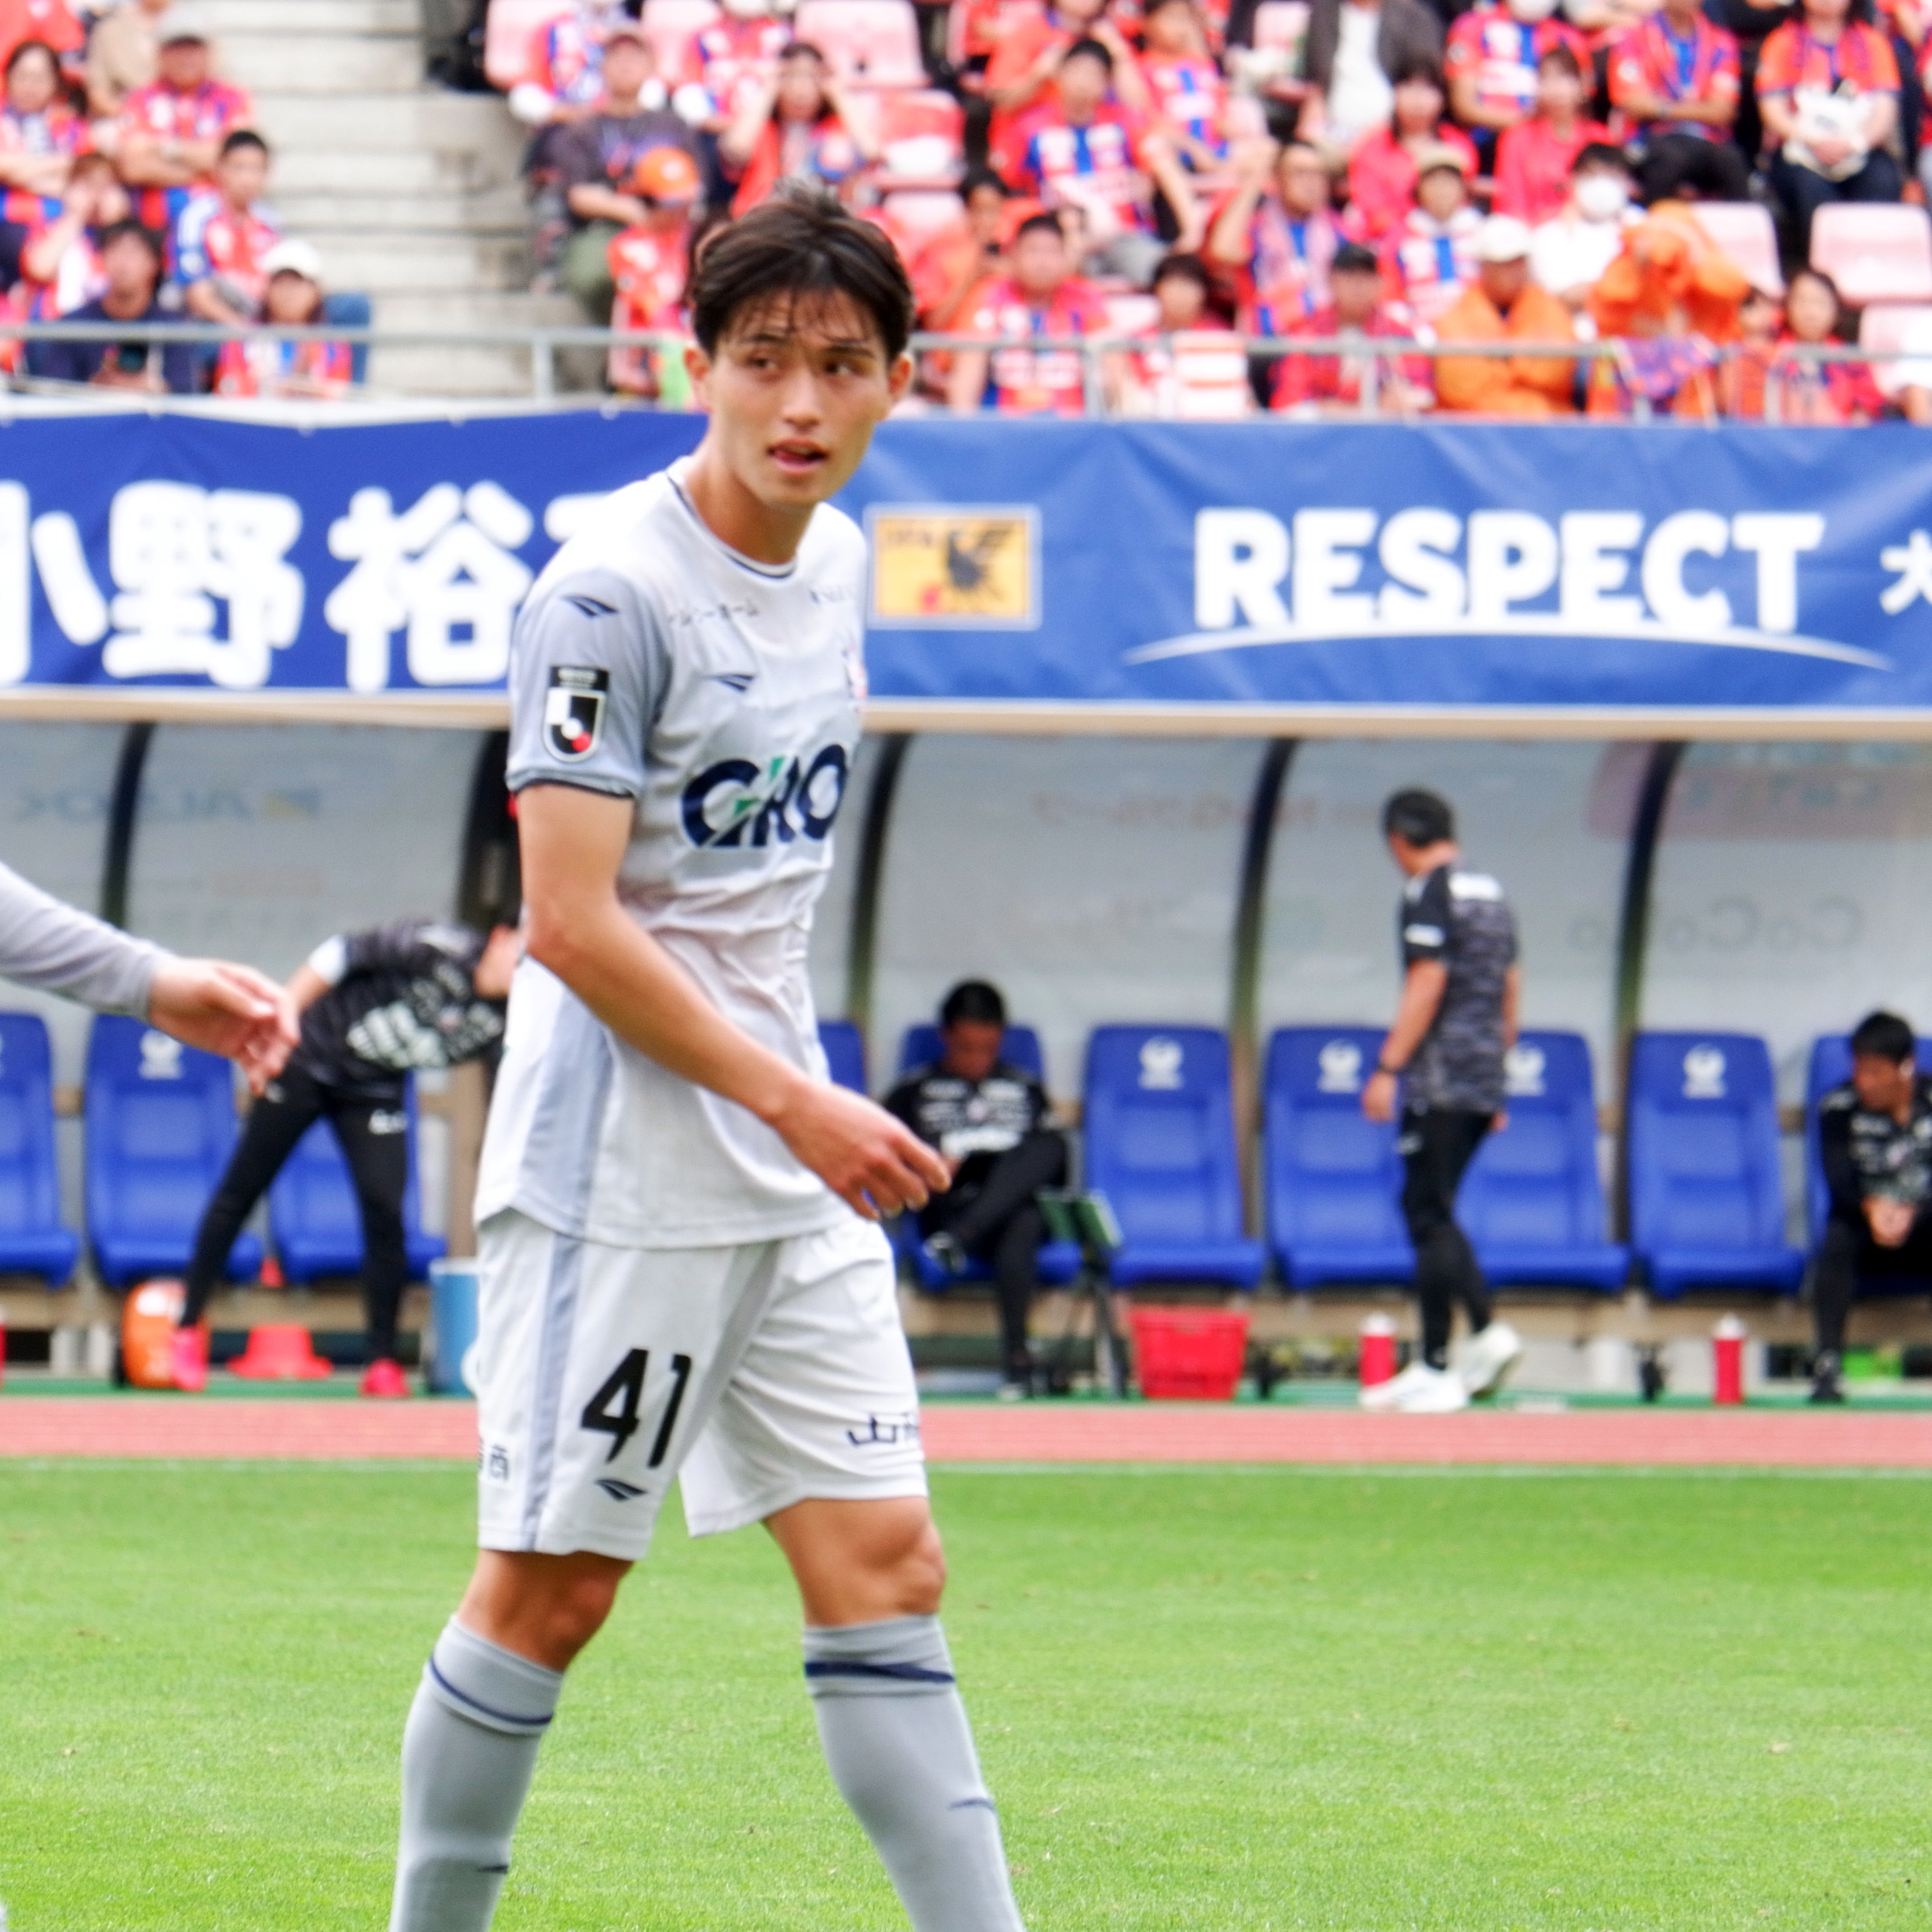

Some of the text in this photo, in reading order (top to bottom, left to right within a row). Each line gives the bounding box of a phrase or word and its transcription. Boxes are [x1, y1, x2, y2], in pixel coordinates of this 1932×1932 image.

[0, 480, 581, 691] 小野裕
[1195, 505, 1826, 633] RESPECT
[581, 1347, 691, 1469] 41
